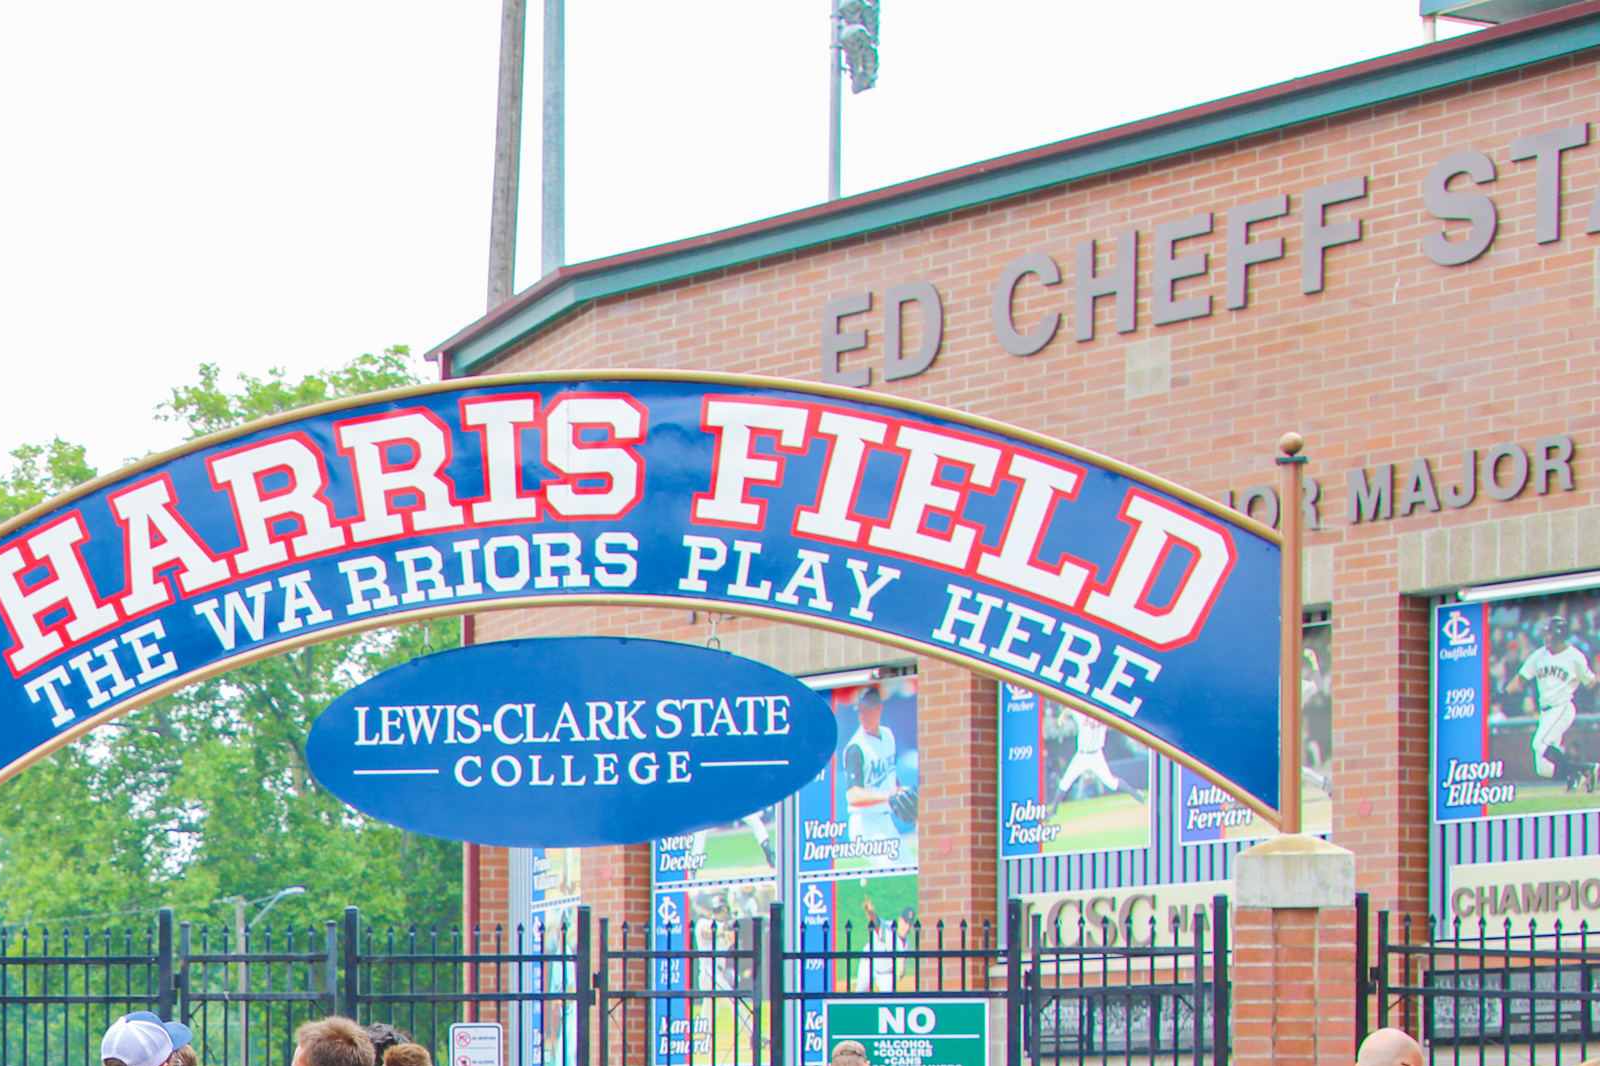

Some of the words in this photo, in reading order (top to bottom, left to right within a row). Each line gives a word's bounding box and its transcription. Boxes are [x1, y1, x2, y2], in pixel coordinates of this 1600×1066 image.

[821, 280, 943, 387] ED
[993, 175, 1367, 357] CHEFF
[1420, 122, 1600, 266] ST
[1347, 434, 1576, 525] MAJOR
[691, 393, 1238, 652] FIELD
[24, 619, 178, 728] THE
[195, 531, 640, 652] WARRIORS
[678, 535, 901, 622] PLAY
[932, 583, 1163, 718] HERE
[1439, 645, 1478, 661] Outfield
[1006, 701, 1036, 713] Pitcher
[1445, 687, 1475, 705] 1999
[353, 700, 647, 746] LEWIS-CLARK
[655, 695, 791, 741] STATE
[1443, 703, 1475, 721] 2000
[1008, 745, 1033, 761] 1999
[454, 751, 693, 788] COLLEGE
[1442, 759, 1505, 789] Jason
[1445, 782, 1517, 808] Ellison
[1005, 799, 1048, 828] John
[803, 819, 848, 840] Victor
[1007, 823, 1061, 845] Foster
[659, 833, 695, 853] Steve
[802, 834, 900, 861] Darensbourg
[658, 850, 708, 873] Decker
[877, 1005, 937, 1035] NO
[879, 1040, 933, 1049] ALCOHOL
[879, 1048, 933, 1057] COOLERS
[890, 1057, 922, 1066] CANS
